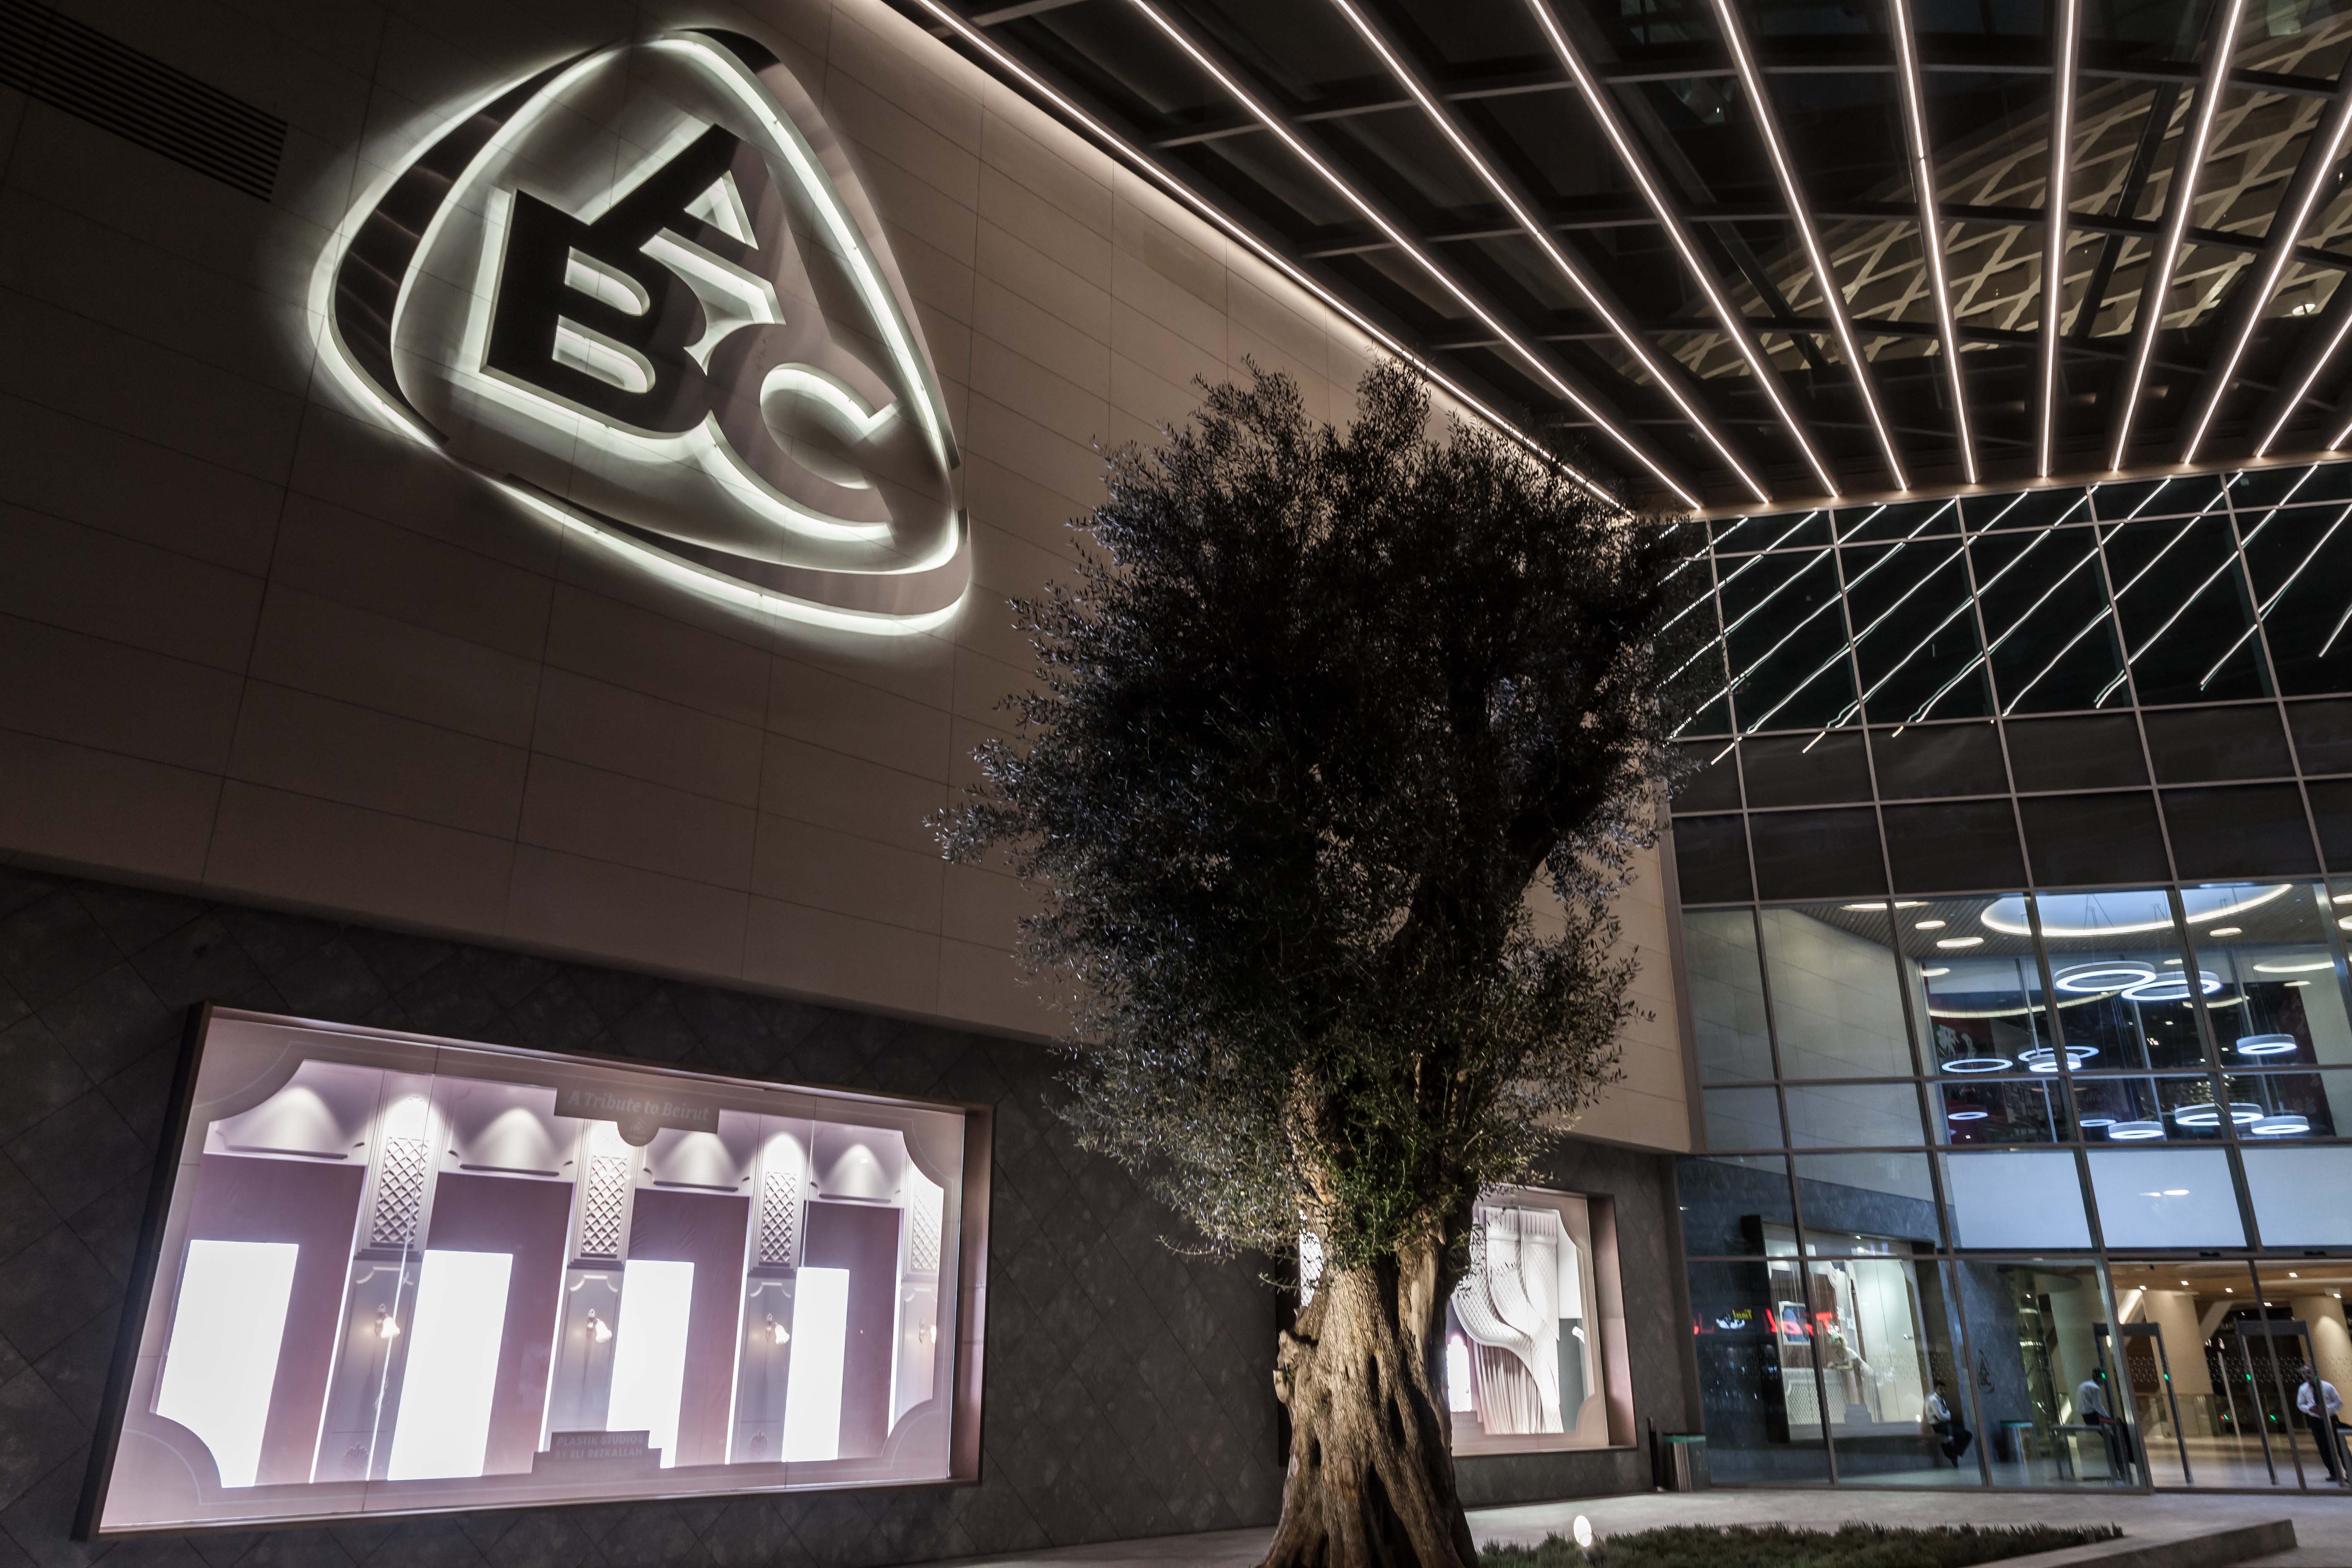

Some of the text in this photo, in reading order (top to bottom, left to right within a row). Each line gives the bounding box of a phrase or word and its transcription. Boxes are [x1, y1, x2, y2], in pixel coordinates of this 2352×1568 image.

[479, 123, 897, 528] ABC
[567, 1090, 709, 1122] A Tribute to Beirut
[556, 1434, 644, 1447] PLASTIK STUDIOS
[555, 1447, 643, 1460] BY ELI REZKALLAH
